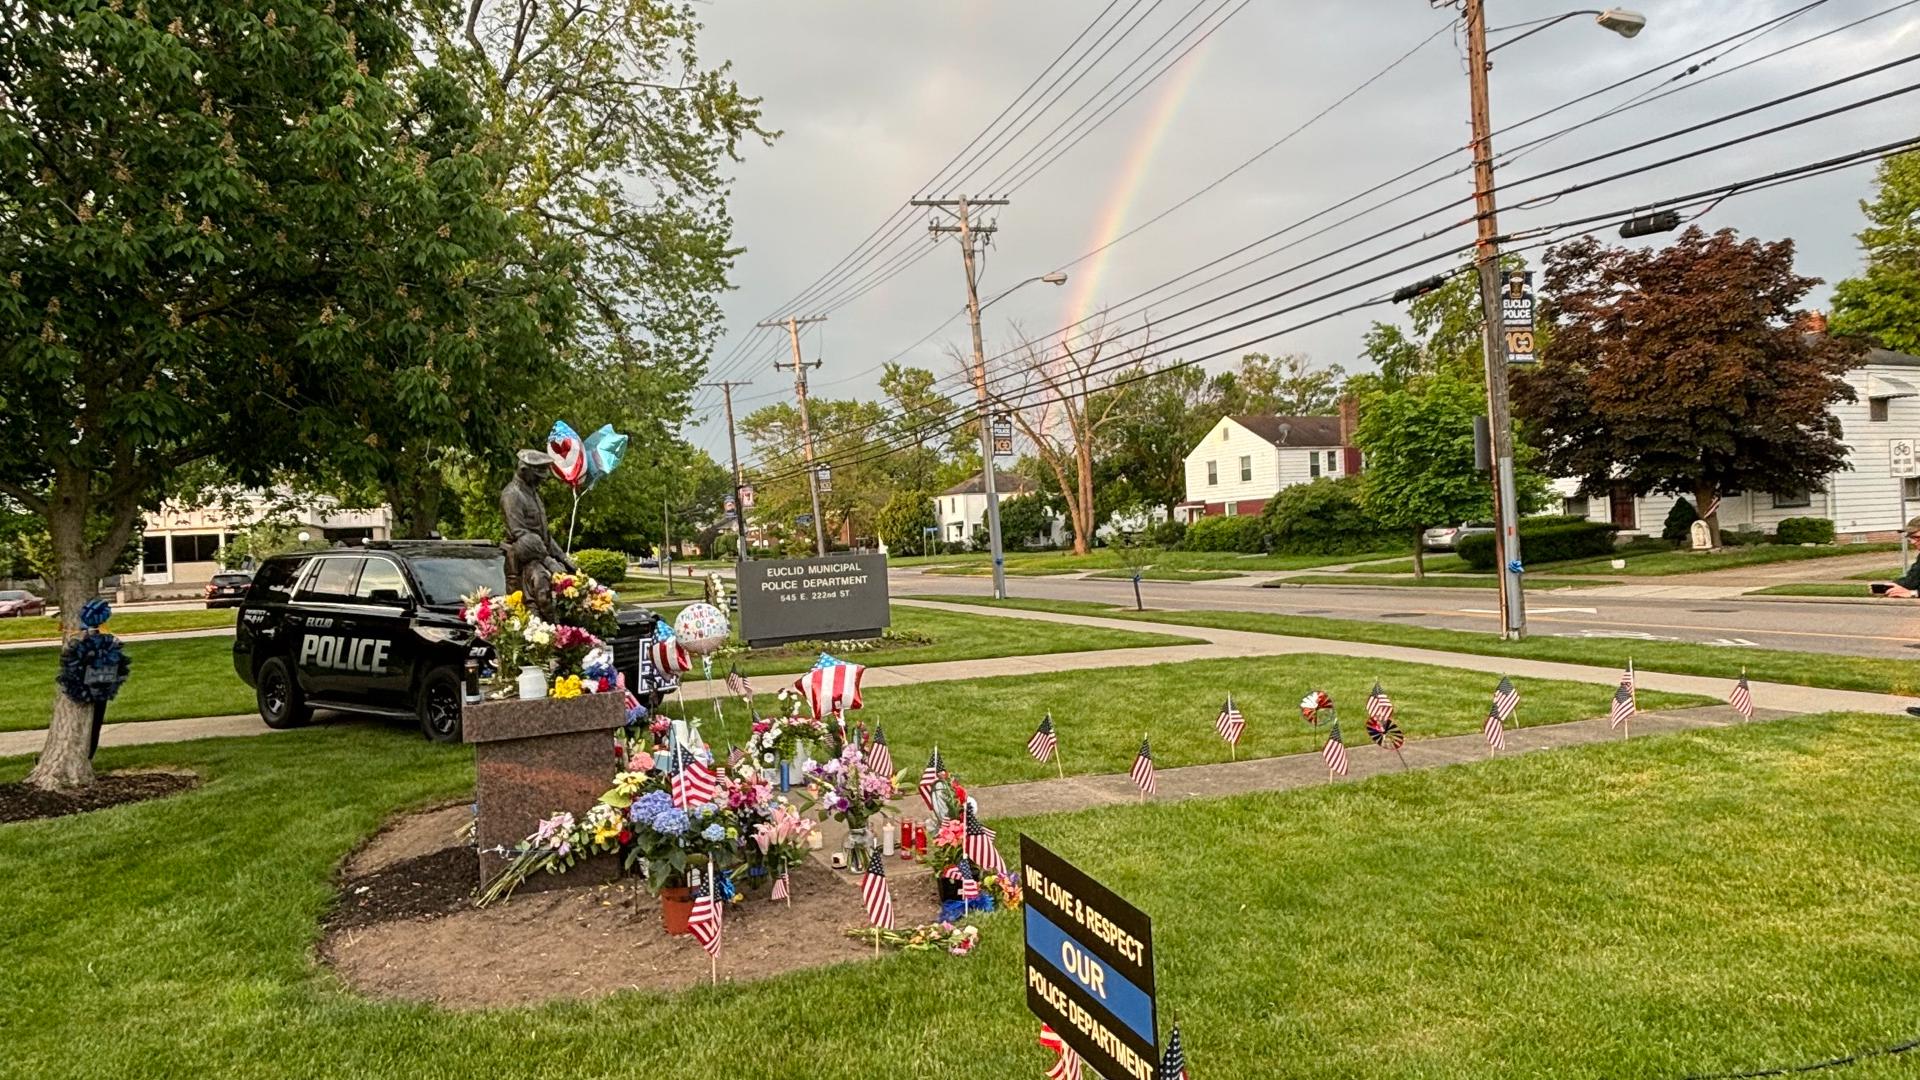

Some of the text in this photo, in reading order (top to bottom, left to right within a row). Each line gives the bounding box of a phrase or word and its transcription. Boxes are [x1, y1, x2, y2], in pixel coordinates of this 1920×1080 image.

[1503, 299, 1531, 309] EUCLID
[1503, 309, 1531, 319] POLICE
[1505, 332, 1534, 353] 100
[767, 562, 861, 577] EUCLID MUNICIPAL
[761, 575, 868, 591] POLICE DEPARTMENT
[780, 593, 797, 602] 545
[812, 591, 837, 600] 222nd
[680, 609, 720, 620] THINKING
[305, 617, 334, 628] EUCLID
[695, 620, 705, 629] OF
[299, 634, 392, 673] POLICE
[469, 646, 488, 656] 20
[1025, 864, 1144, 967] WE LOVE & RESPECT
[1062, 940, 1106, 999] OUR
[1029, 965, 1153, 1080] POLICE DEPARTMENT
